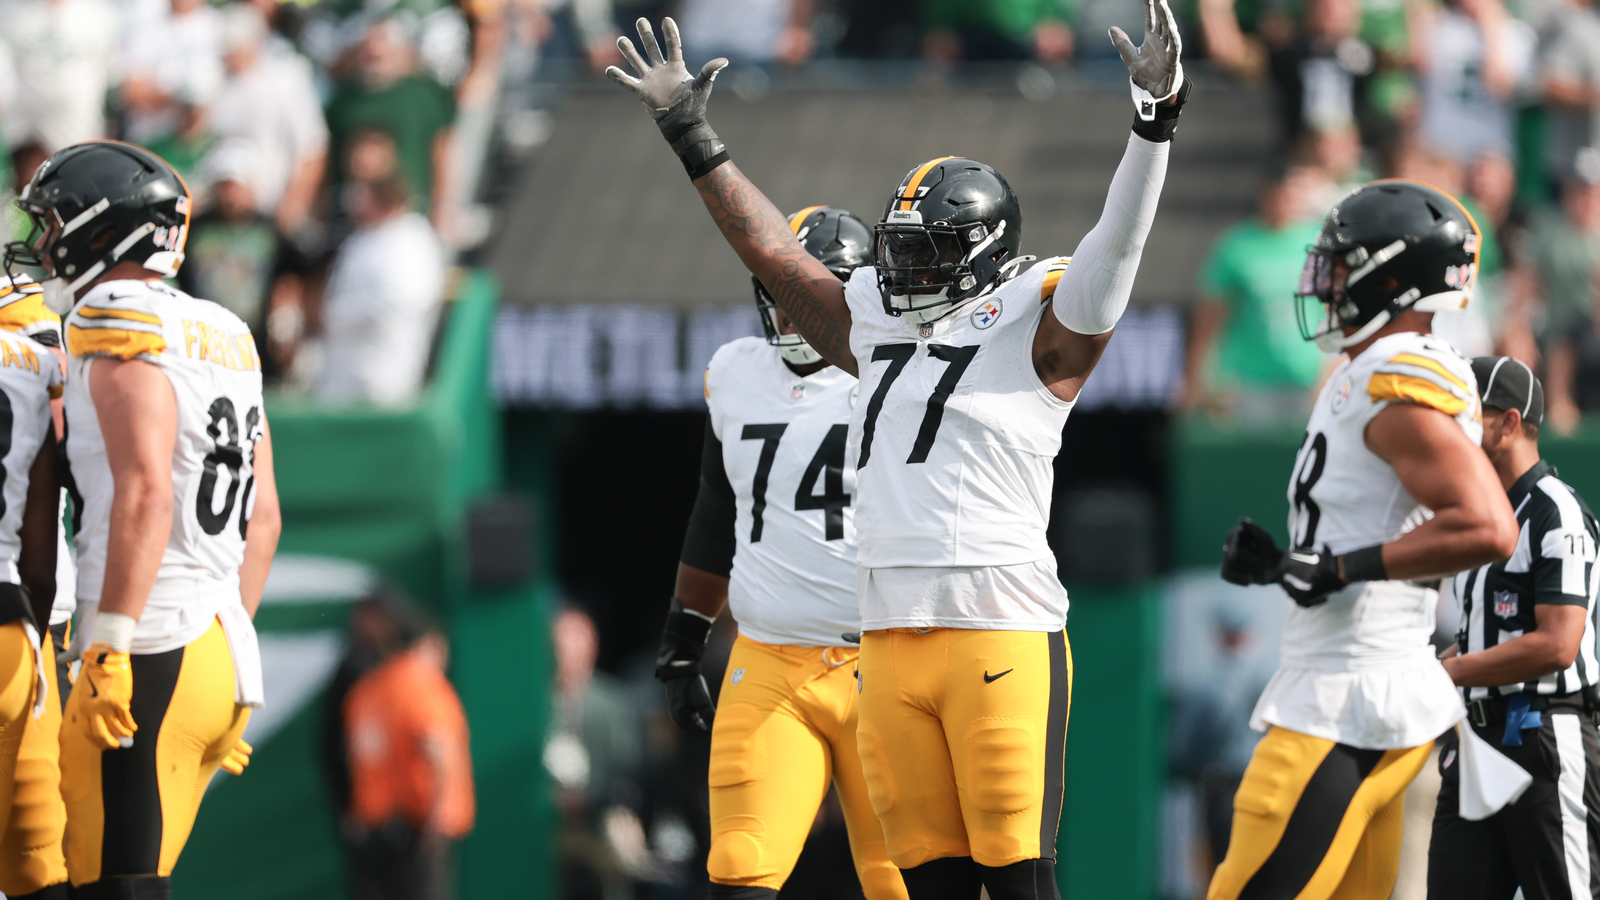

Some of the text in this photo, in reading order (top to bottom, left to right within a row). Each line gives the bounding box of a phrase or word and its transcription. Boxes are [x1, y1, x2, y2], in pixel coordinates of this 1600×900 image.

[771, 277, 845, 354] HUMBLE
[857, 343, 981, 471] 77
[741, 423, 852, 544] 74
